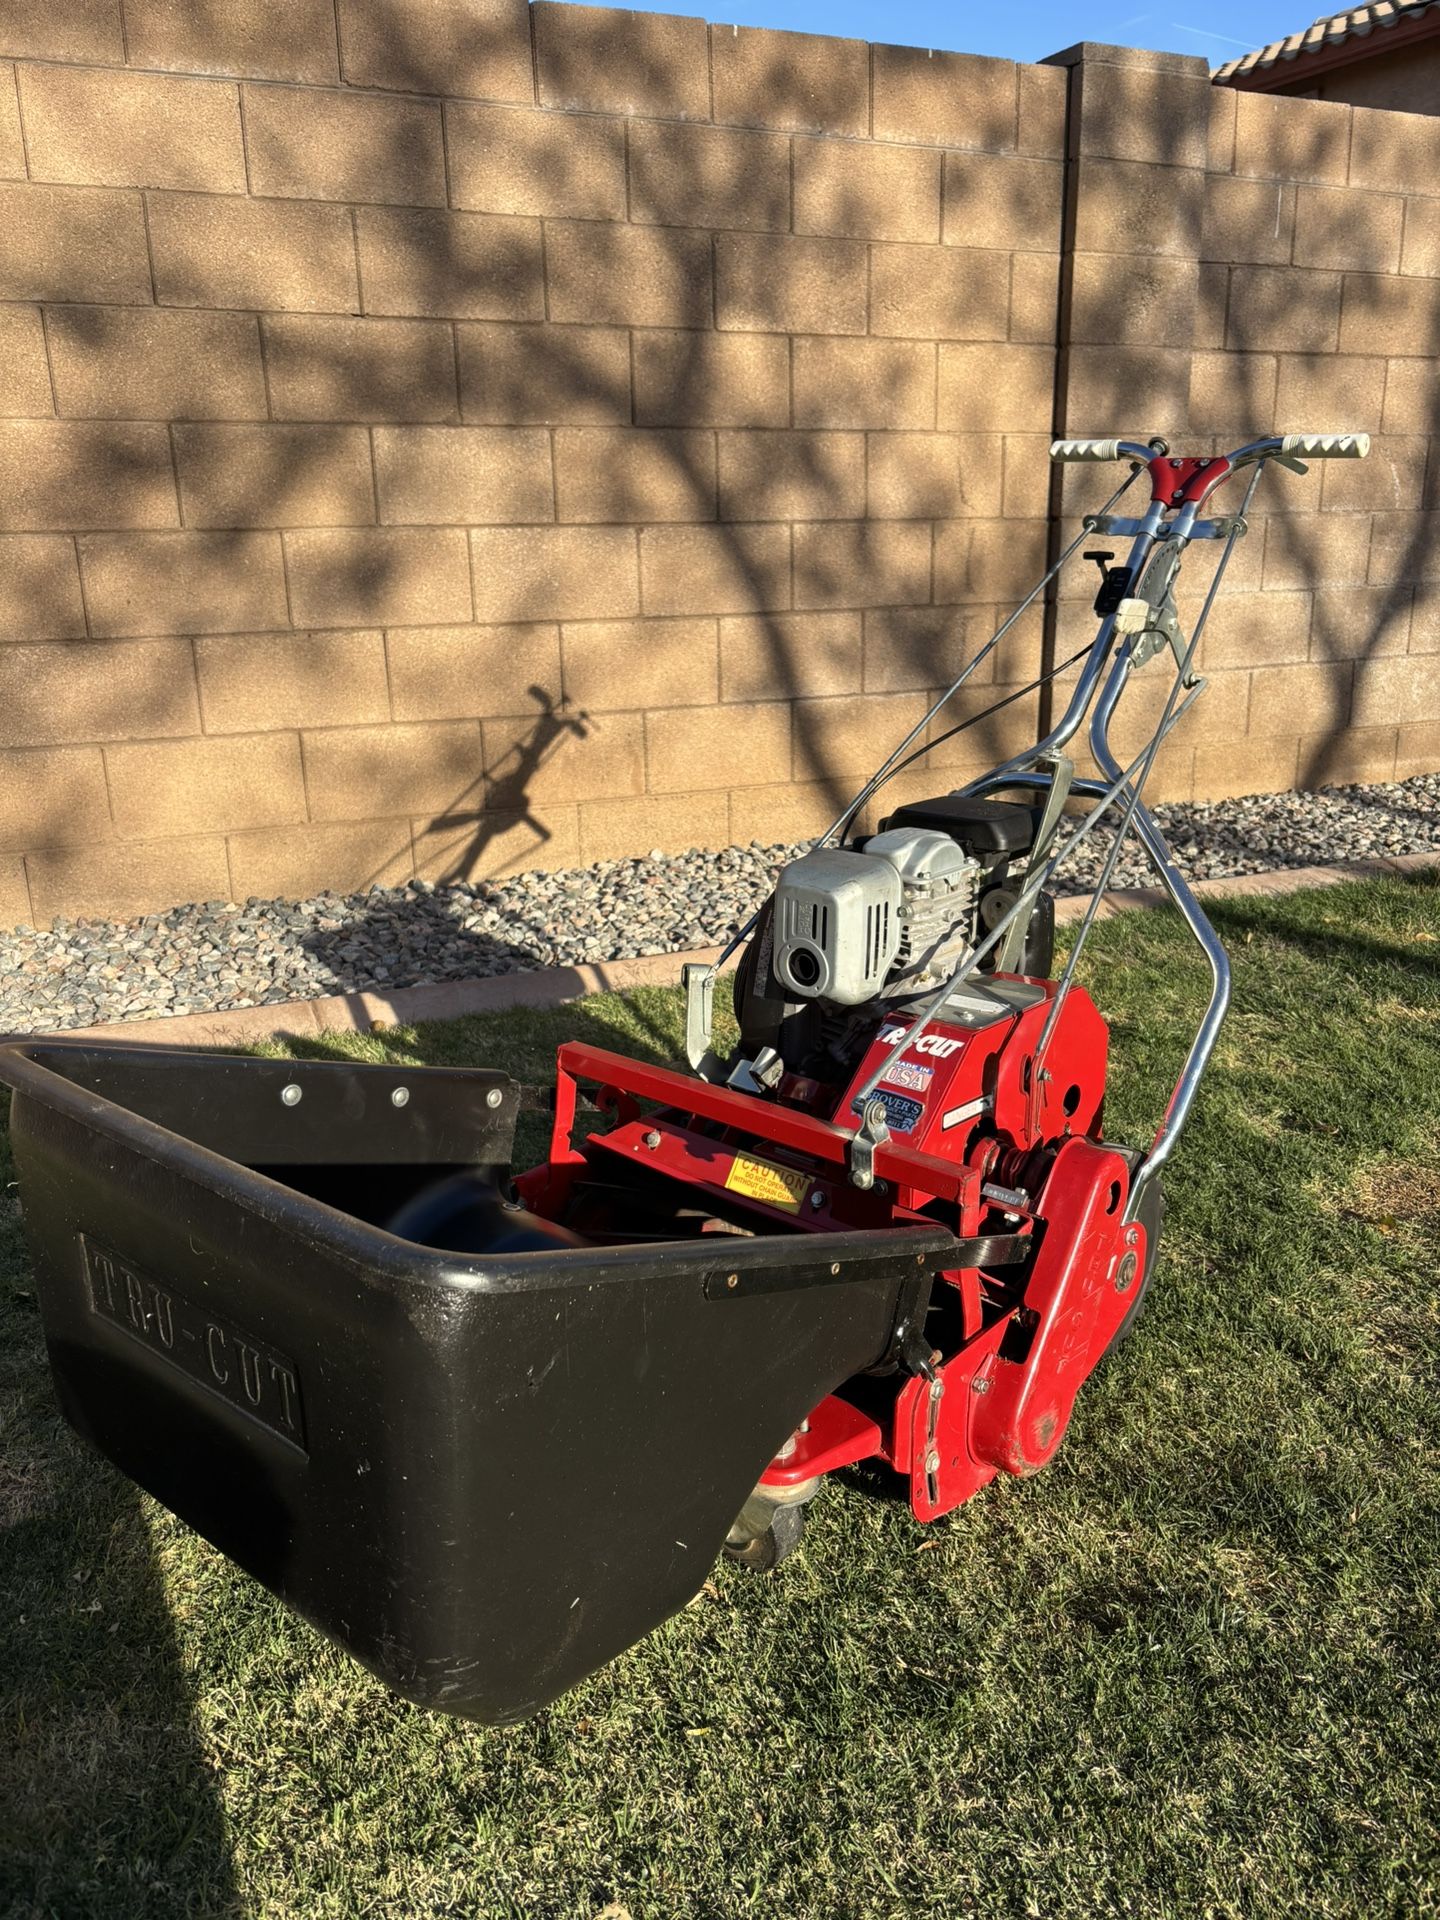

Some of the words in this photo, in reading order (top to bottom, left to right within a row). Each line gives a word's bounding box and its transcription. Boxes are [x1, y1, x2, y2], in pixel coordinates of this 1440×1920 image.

[876, 1024, 966, 1058] TR-CUT
[886, 1066, 924, 1090] USA
[920, 1066, 930, 1074] IN
[742, 1158, 805, 1190] CAUTION
[745, 1172, 754, 1180] DO
[754, 1174, 767, 1183] NOT
[733, 1175, 759, 1190] WITHOUT
[759, 1183, 777, 1196] CHAIN
[777, 1188, 800, 1202] GUA
[92, 1250, 296, 1430] TRU-CUT
